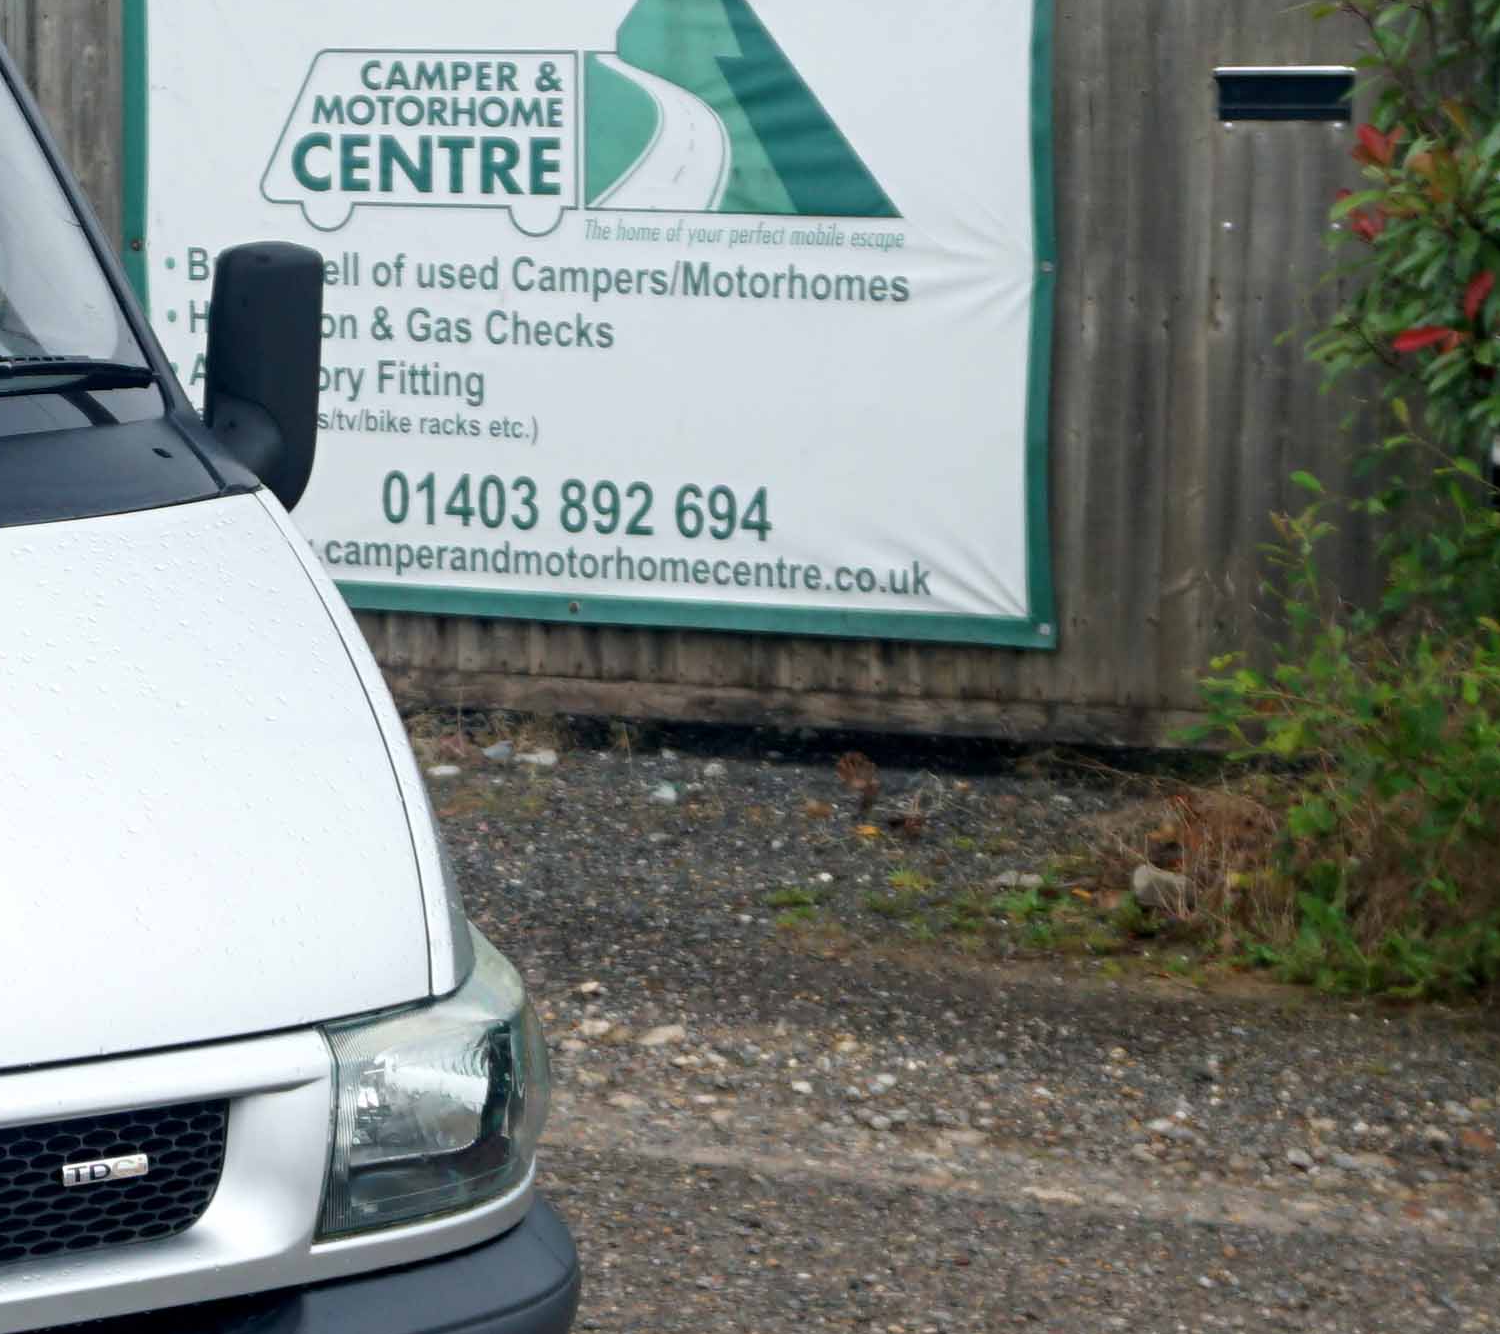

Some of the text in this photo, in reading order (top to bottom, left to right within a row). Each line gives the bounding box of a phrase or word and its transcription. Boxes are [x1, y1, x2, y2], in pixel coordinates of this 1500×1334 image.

[360, 60, 563, 92] CAMPER &
[312, 95, 563, 127] MOTORHOME
[291, 131, 561, 195] CENTRE
[584, 218, 905, 252] The home of your perfect mobile escape
[323, 252, 911, 303] ell of used Campers/Motorhomes
[370, 306, 394, 341] &
[406, 307, 472, 344] Gas
[485, 309, 615, 348] Checks
[377, 359, 485, 407] Fitting
[317, 408, 539, 445] s/tv/bike racks etc.)
[382, 469, 773, 542] 01403 892 694
